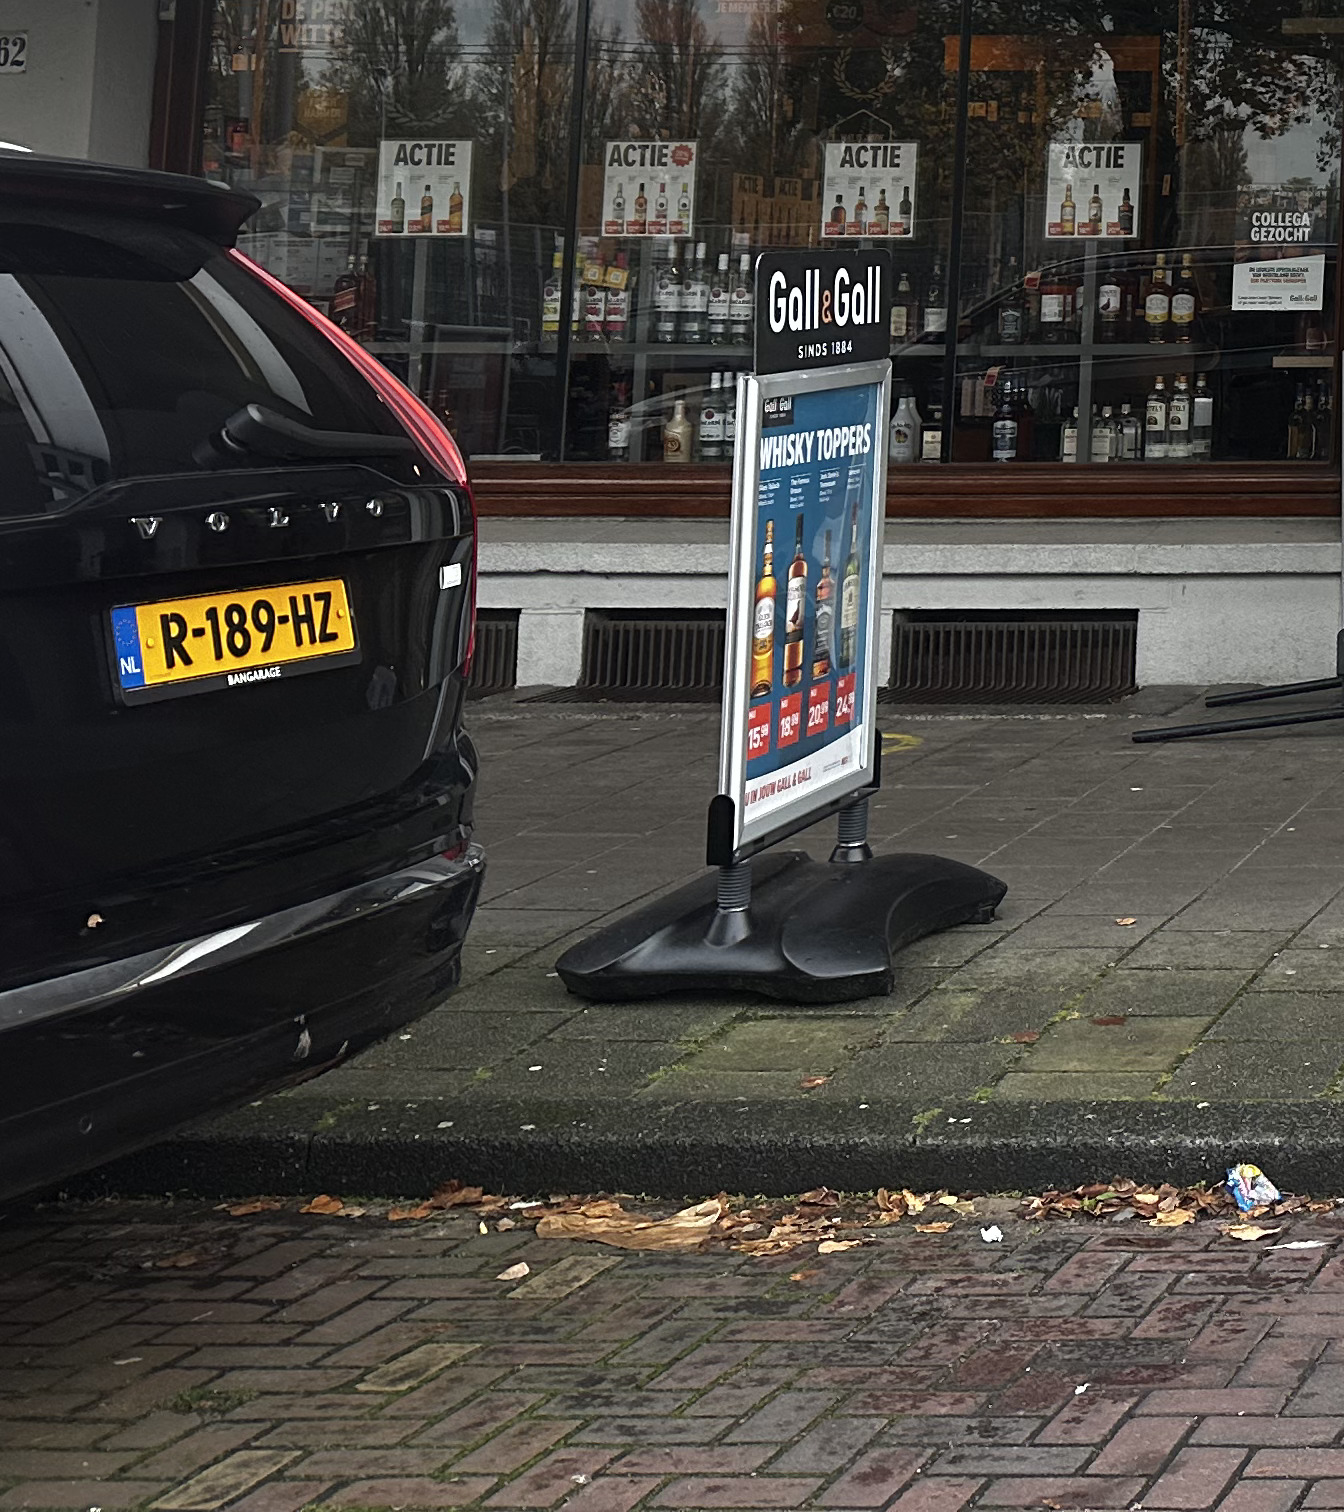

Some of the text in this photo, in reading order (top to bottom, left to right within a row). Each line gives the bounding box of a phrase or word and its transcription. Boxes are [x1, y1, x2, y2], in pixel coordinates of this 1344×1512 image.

[393, 142, 457, 167] ACTIE
[608, 143, 670, 168] ACTIE
[839, 145, 902, 168] ACTIE
[1062, 145, 1125, 169] ACTIE
[1252, 211, 1310, 227] COLLEGA
[1251, 227, 1312, 242] GEZOCHT
[797, 339, 853, 359] SINDS 1884
[759, 422, 872, 471] WHISKY TOPPERS
[127, 498, 385, 540] VOLVO
[159, 590, 339, 670] R-189-HZ
[119, 655, 141, 675] NL
[227, 665, 282, 687] BANGARAGE
